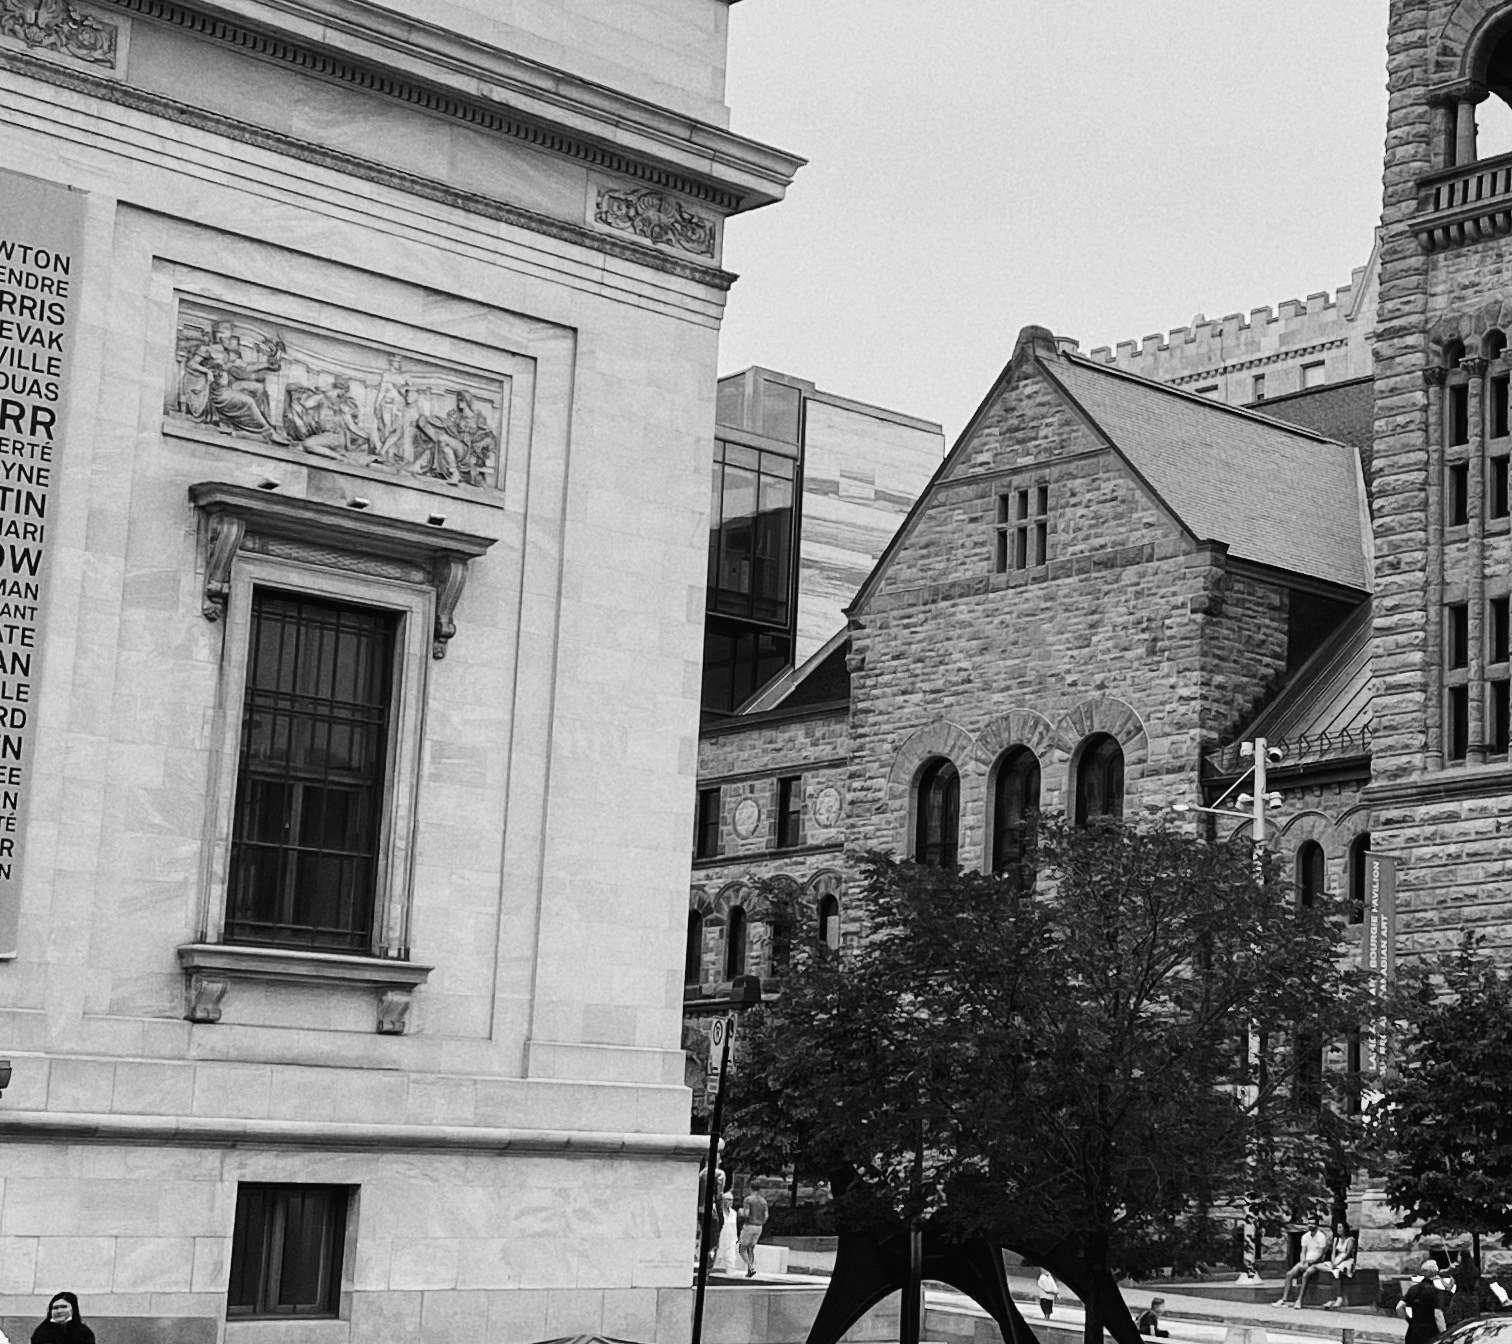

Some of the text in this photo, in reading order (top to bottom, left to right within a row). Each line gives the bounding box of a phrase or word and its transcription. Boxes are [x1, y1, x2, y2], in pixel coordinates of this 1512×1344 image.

[0, 289, 65, 326] RRIS
[0, 319, 63, 353] EVAK
[0, 398, 56, 441] RR
[0, 437, 53, 462] ERTÉ
[0, 485, 46, 518] TIN
[0, 602, 38, 621] ANT
[1, 680, 30, 703] LE
[1380, 913, 1389, 938] ART
